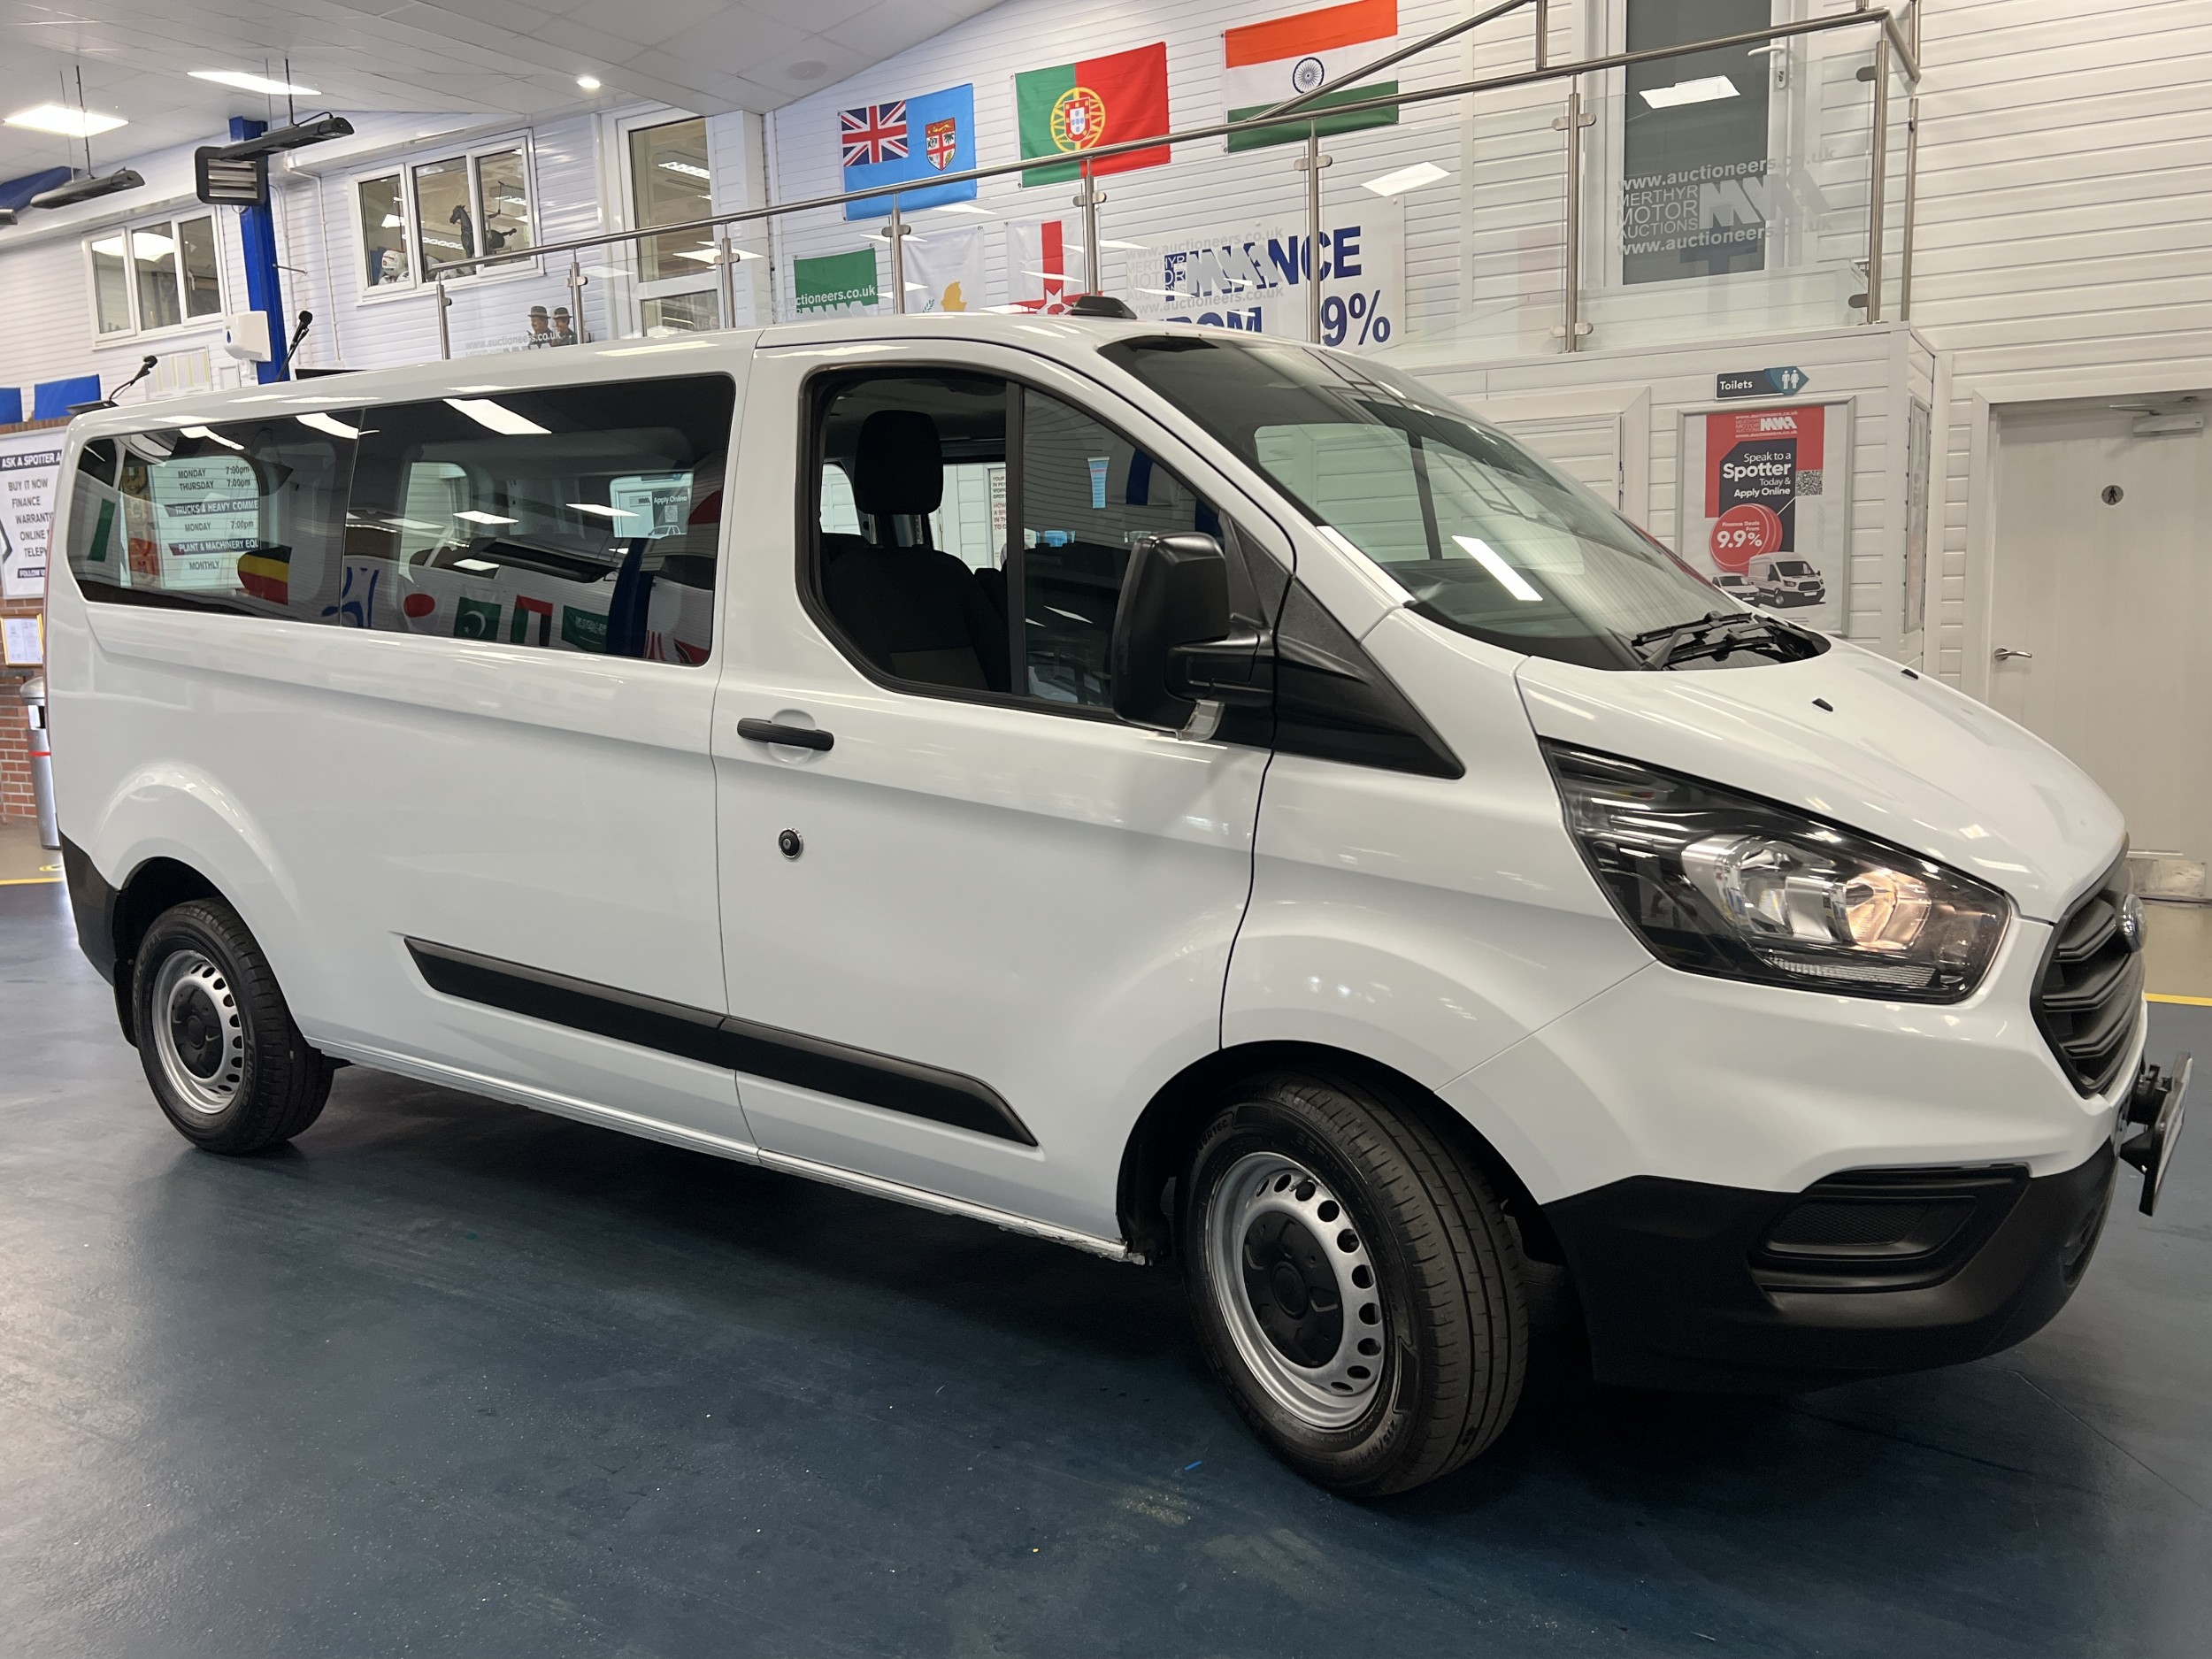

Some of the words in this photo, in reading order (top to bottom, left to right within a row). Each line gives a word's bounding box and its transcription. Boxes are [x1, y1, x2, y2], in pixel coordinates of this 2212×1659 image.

[1617, 185, 1698, 208] MERTHYR
[1617, 200, 1698, 226] MOTOR
[1617, 218, 1698, 240] AUCTIONS
[1719, 380, 1753, 391] Toilets
[1, 457, 17, 468] ASK
[17, 457, 24, 467] A
[24, 452, 55, 466] SPOTTER
[1743, 451, 1772, 465] Speak
[178, 468, 206, 479] MONDAY
[226, 465, 250, 475] 7:00pm
[1723, 462, 1792, 482] Spotter
[8, 480, 24, 491] BUY
[24, 480, 30, 489] IT
[32, 479, 49, 488] NOW
[179, 480, 214, 491] THURSDAY
[1759, 478, 1784, 488] Today
[1733, 488, 1760, 498] Apply
[1761, 487, 1791, 495] Online
[12, 496, 41, 508] FINANCE
[653, 495, 670, 504] Apply
[175, 503, 200, 515] TRUCKS
[208, 502, 230, 512] HEAVY
[15, 511, 54, 525] WARRANTI
[184, 522, 211, 532] MONDAY
[230, 520, 254, 530] 7:00pm
[19, 530, 46, 541] ONLINE
[1717, 529, 1763, 549] 9.9%
[179, 542, 198, 552] PLANT
[206, 540, 244, 551] MACHINERY
[188, 560, 219, 570] MONTHLY
